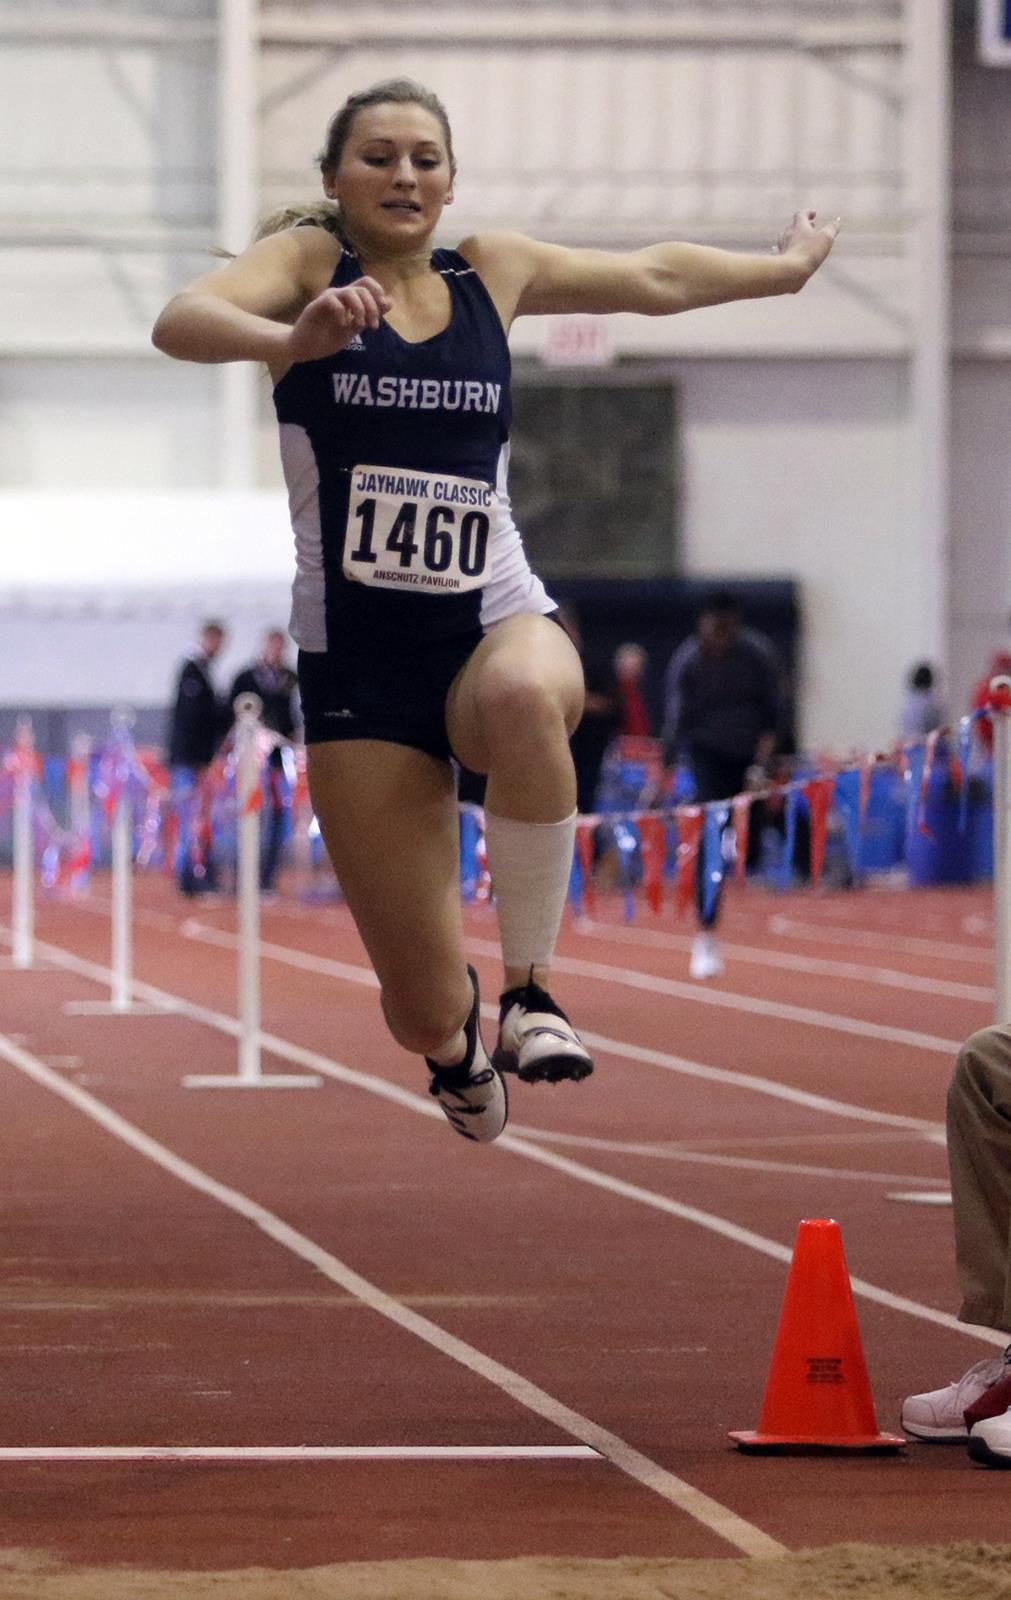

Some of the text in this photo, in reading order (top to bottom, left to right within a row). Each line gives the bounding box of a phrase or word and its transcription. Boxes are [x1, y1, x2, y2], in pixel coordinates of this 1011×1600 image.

[332, 373, 501, 414] WASHBURN
[357, 473, 492, 507] JAYHAWK CLASSIC
[351, 498, 490, 577] 1460
[373, 570, 460, 588] ANSCHUTZ PAVILION
